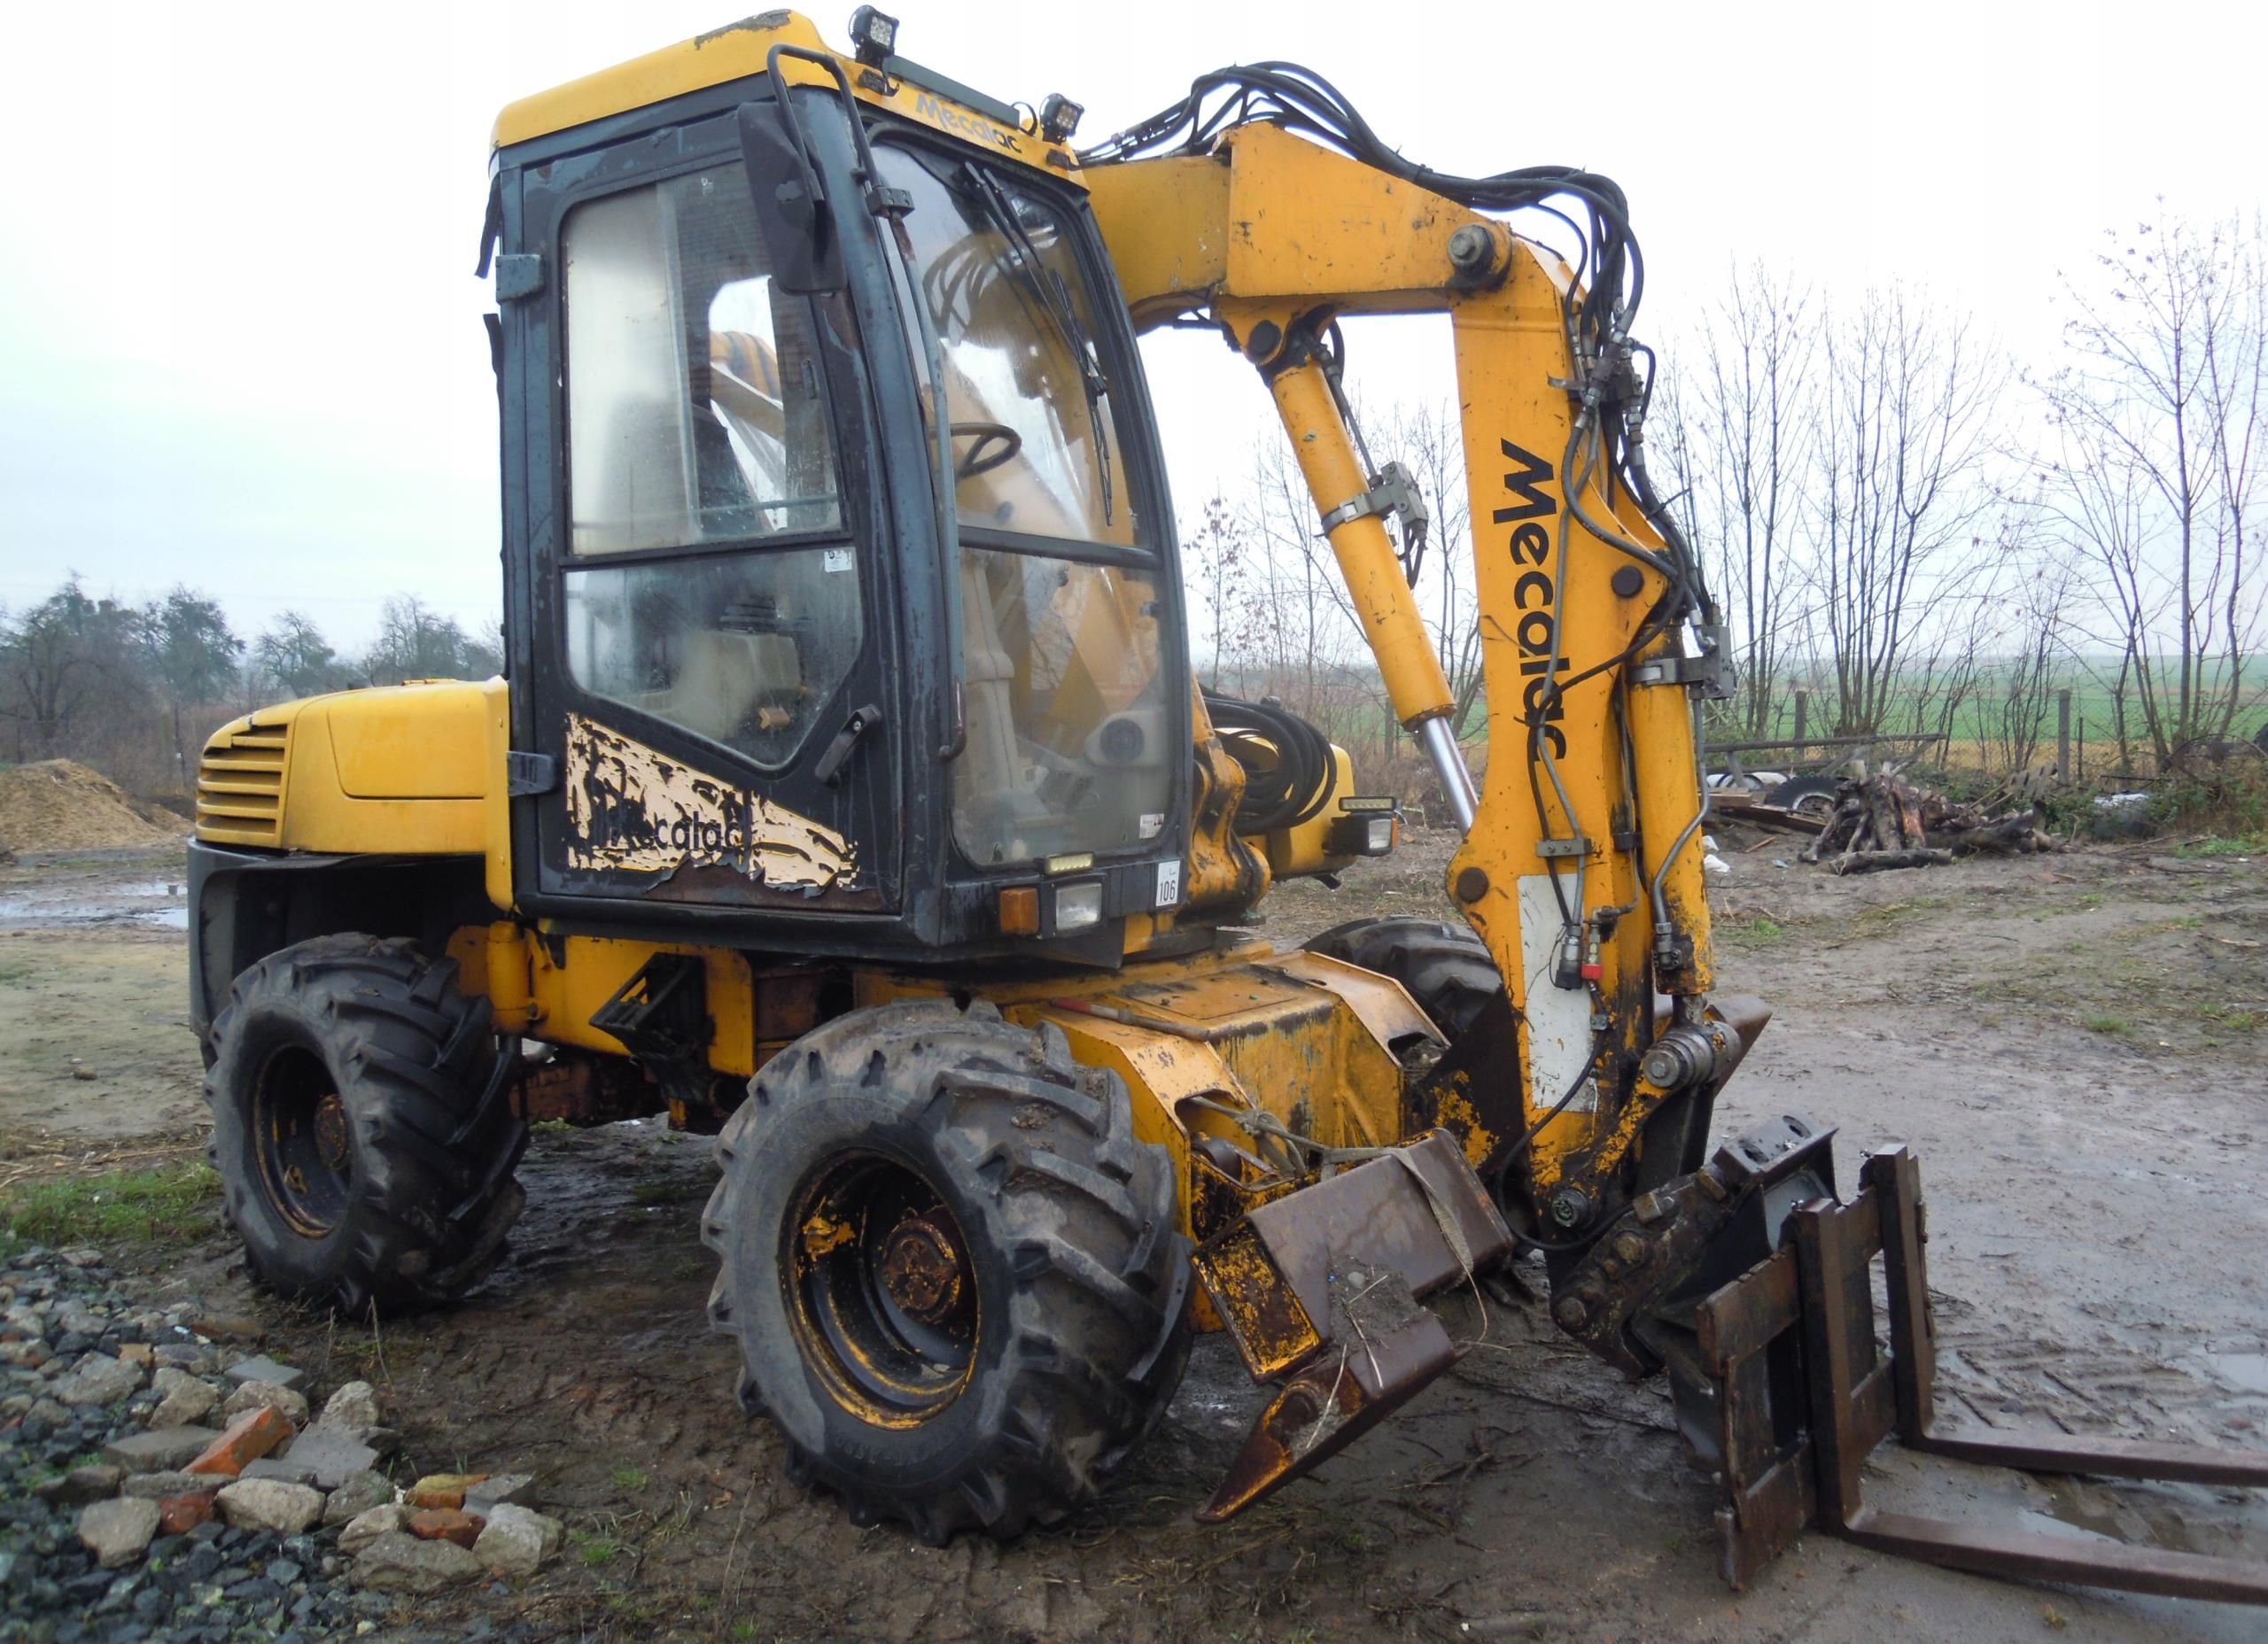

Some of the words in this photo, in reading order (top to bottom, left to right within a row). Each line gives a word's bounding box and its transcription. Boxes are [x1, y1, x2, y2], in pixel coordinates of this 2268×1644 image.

[915, 93, 1022, 154] Mecalac
[1493, 438, 1571, 761] Mecalac
[1159, 880, 1176, 902] 106
